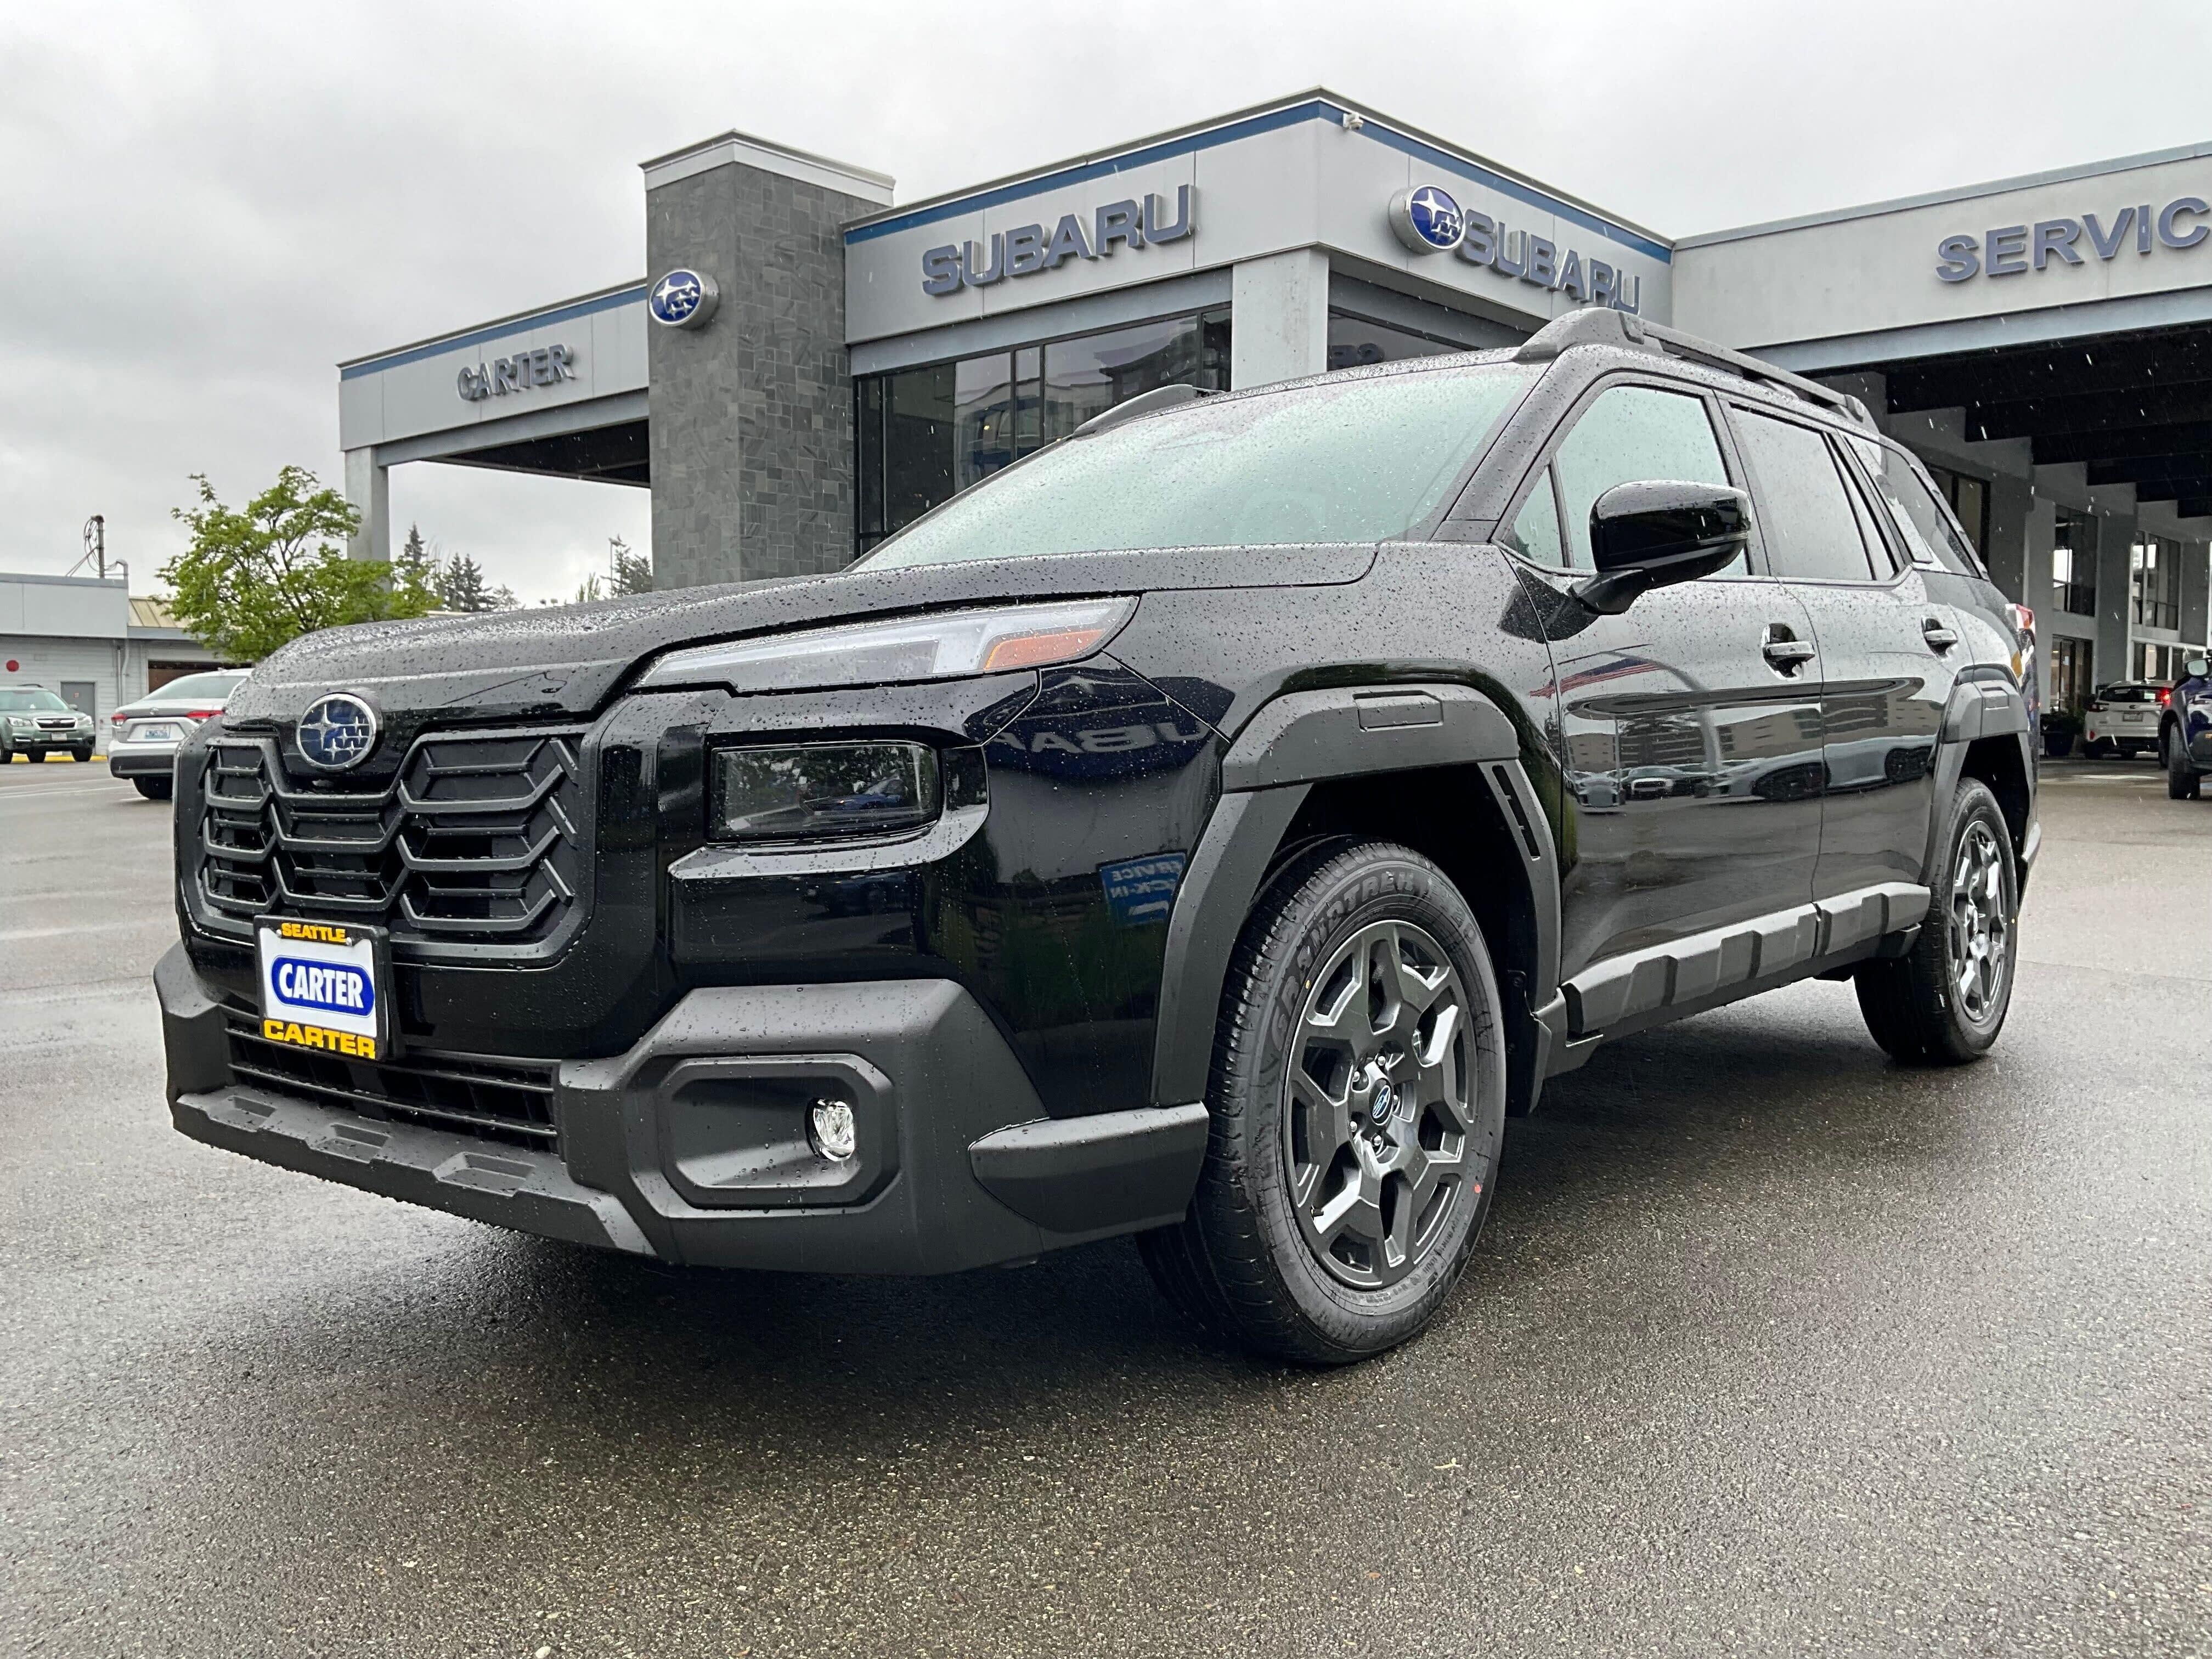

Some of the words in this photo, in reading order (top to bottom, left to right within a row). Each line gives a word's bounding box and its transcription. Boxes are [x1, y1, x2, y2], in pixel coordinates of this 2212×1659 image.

[922, 184, 1194, 296] SUBARU
[1459, 208, 1640, 315] SUBARU
[1936, 197, 2211, 283] SERVIC
[457, 343, 575, 401] CARTER
[281, 923, 347, 943] SEATTLE
[279, 963, 364, 1008] CARTER
[263, 1019, 376, 1059] CARTER
